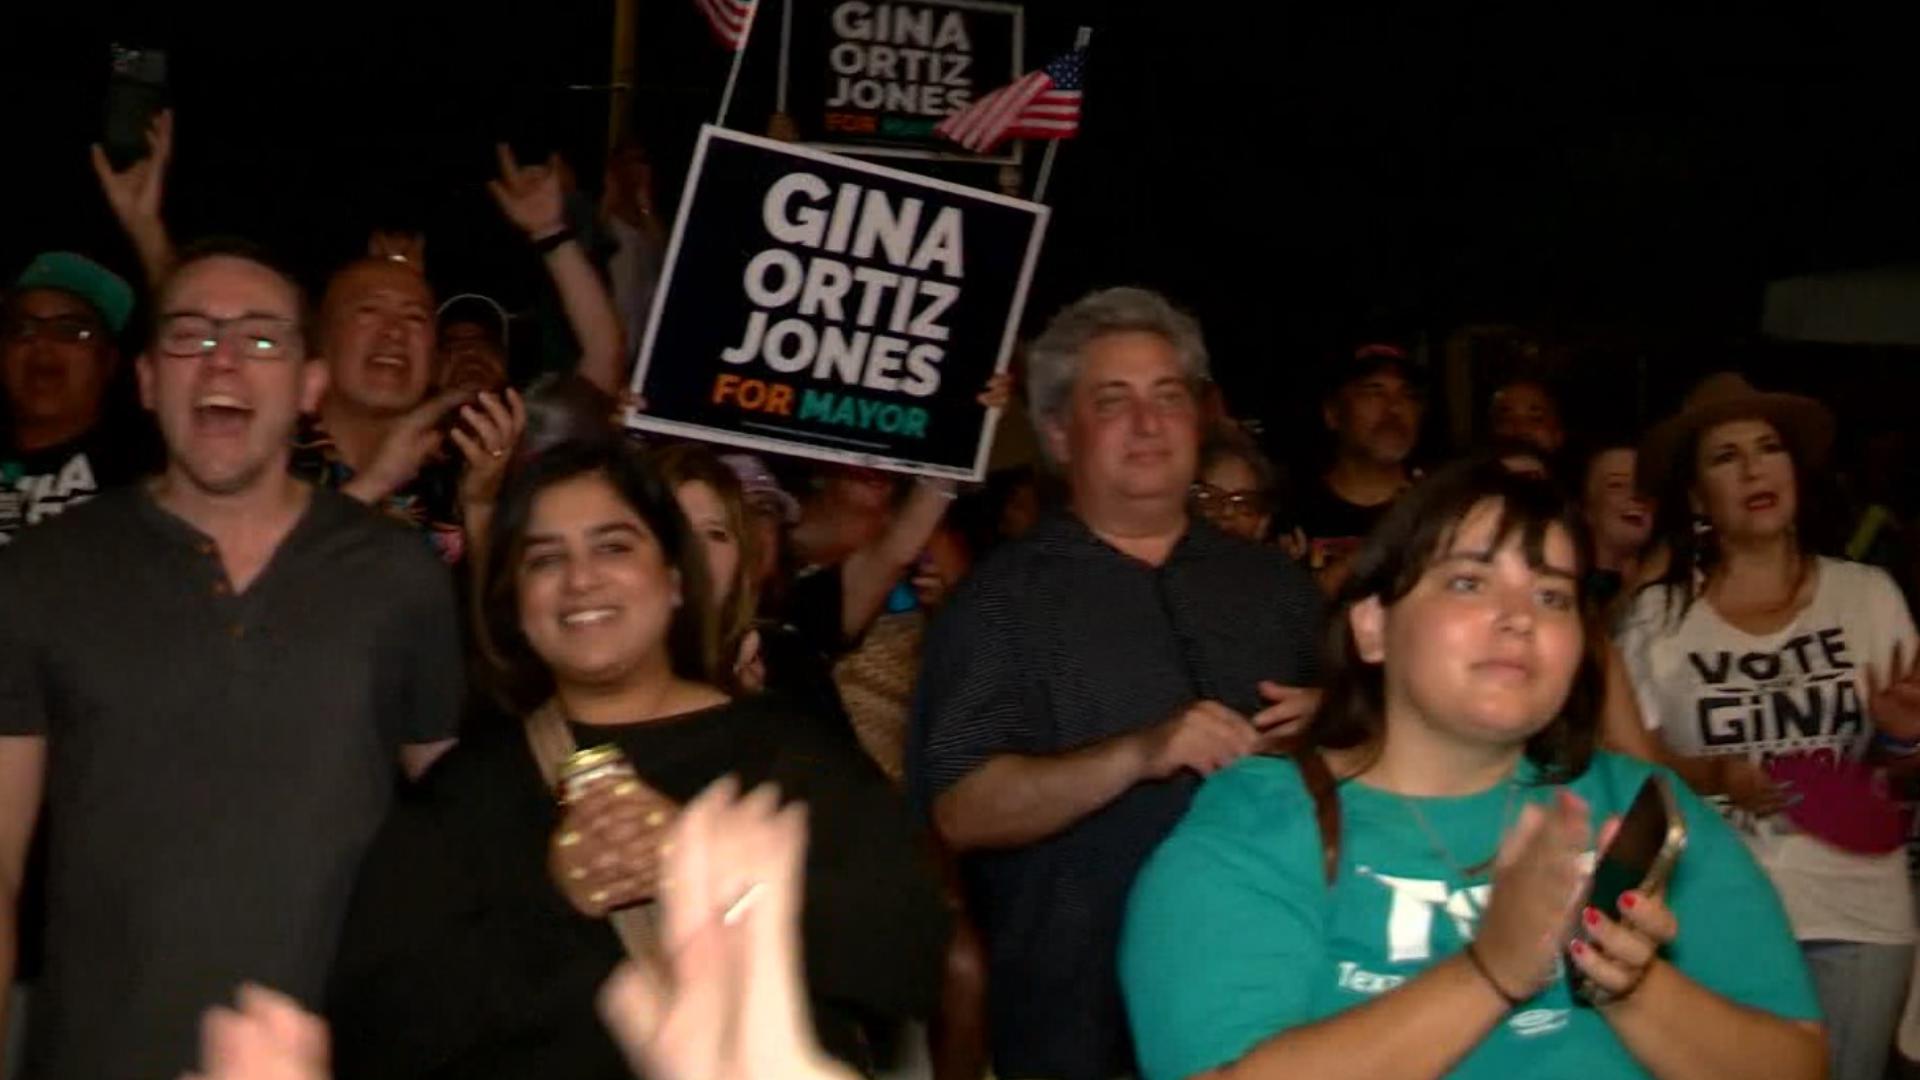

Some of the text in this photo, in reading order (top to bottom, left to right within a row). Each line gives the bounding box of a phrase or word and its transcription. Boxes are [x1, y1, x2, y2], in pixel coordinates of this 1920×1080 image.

[831, 1, 971, 50] GINA
[828, 41, 974, 86] ORTIZ
[824, 77, 974, 116] JONES
[761, 172, 966, 279] GINA
[743, 248, 962, 341] ORTIZ
[720, 311, 946, 397] JONES
[712, 373, 795, 416] FOR
[798, 388, 928, 438] MAYOR
[1688, 627, 1853, 683] VOTE
